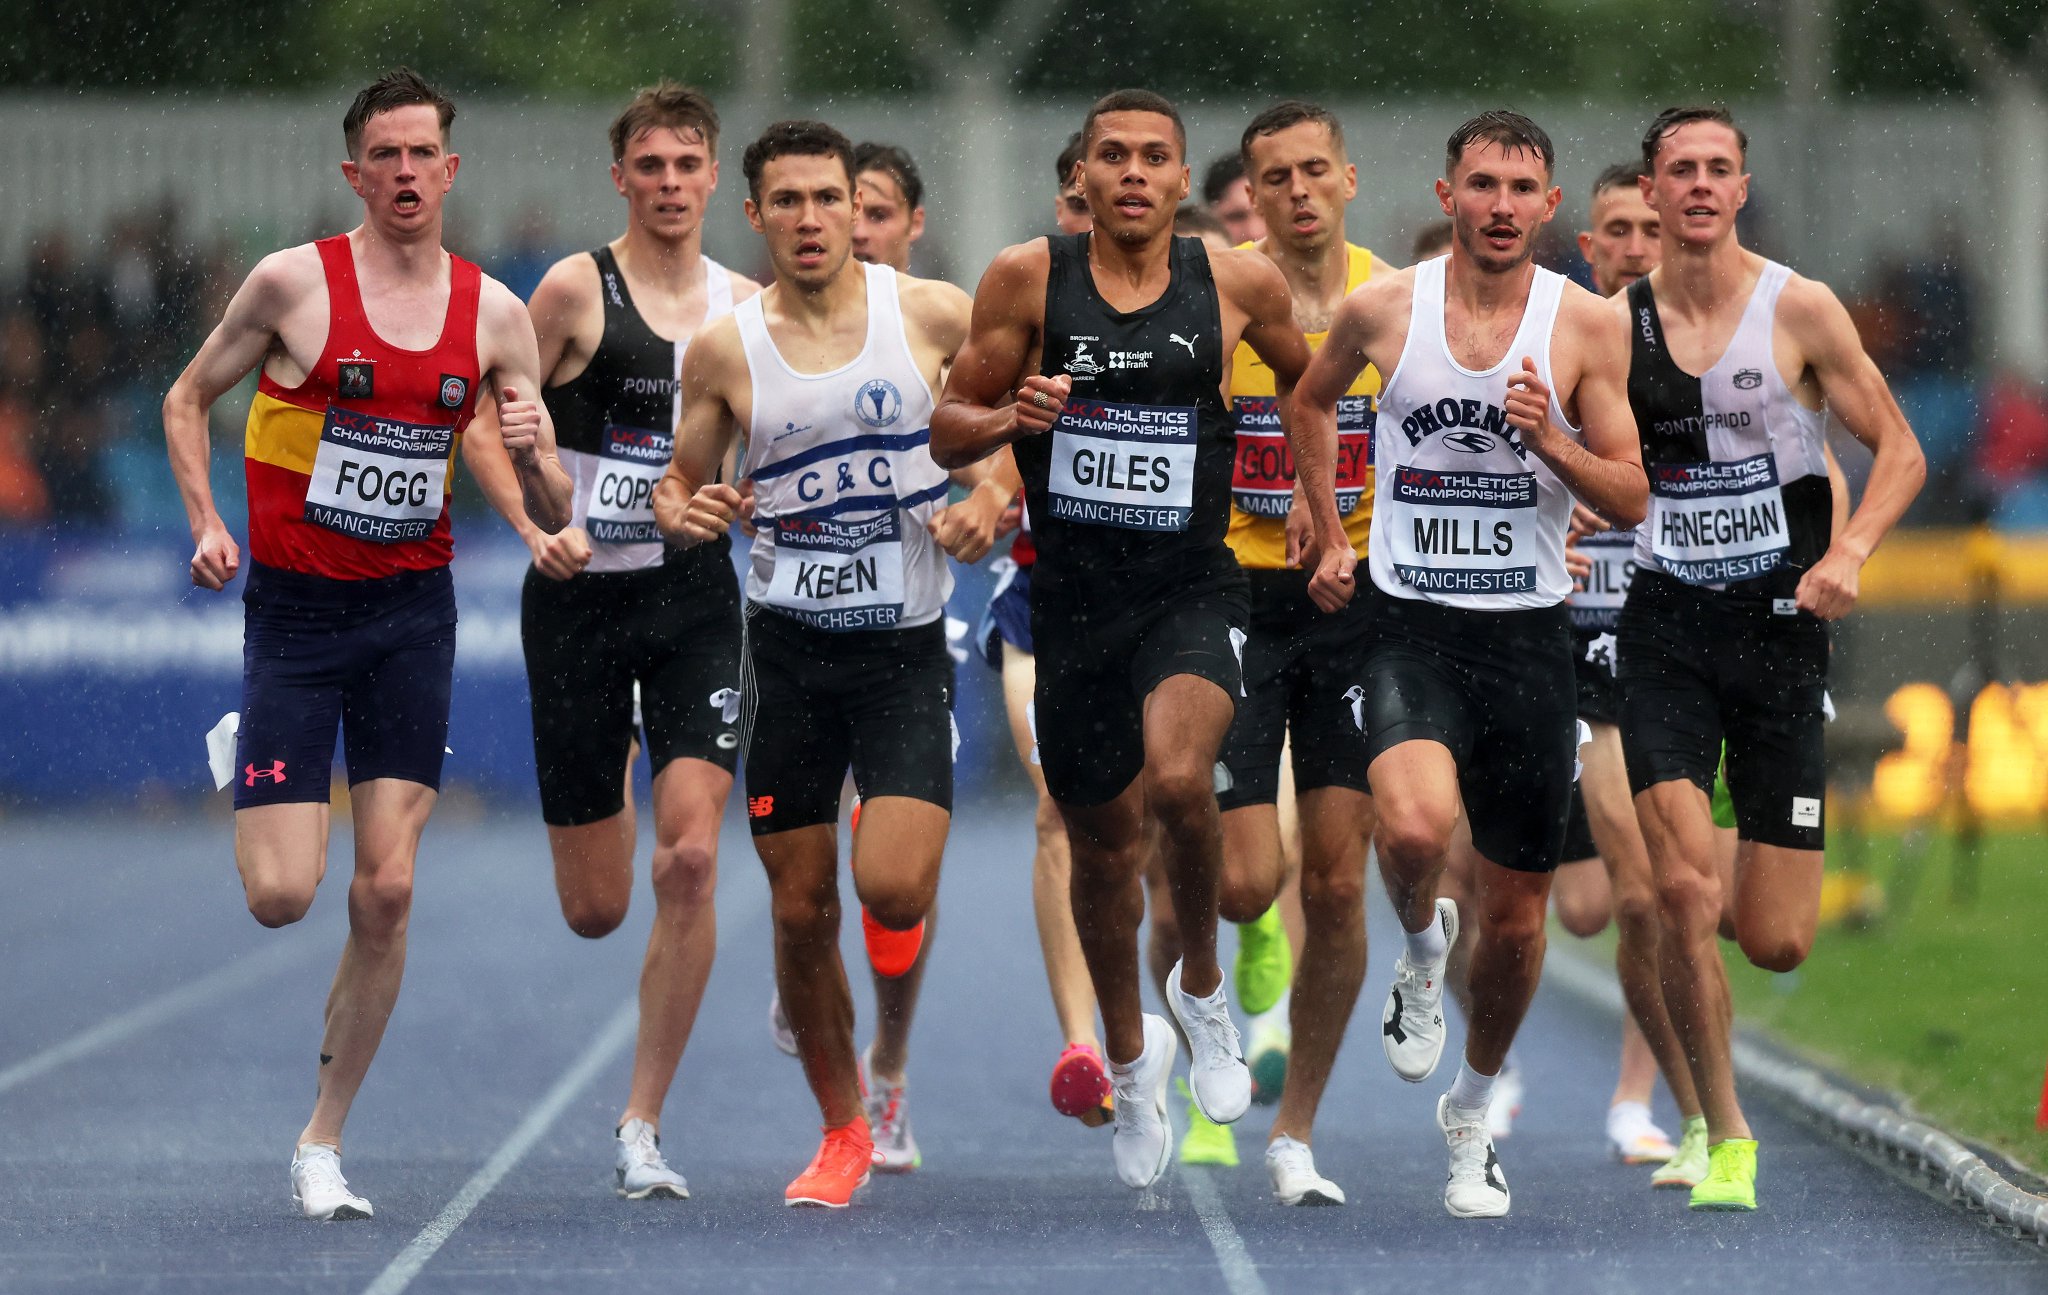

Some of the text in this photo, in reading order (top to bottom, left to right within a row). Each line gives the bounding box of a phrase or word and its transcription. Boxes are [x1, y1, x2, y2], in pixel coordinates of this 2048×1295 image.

[1639, 307, 1657, 345] soar
[1126, 350, 1154, 361] Knight
[1126, 360, 1149, 369] Frank
[1063, 402, 1189, 424] UK ATHLETICS
[1653, 411, 1751, 436] PONTYPRIDD
[334, 412, 451, 441] UK ATHLETICS
[611, 430, 638, 445] UK
[1061, 416, 1189, 436] CHAMPIONSHIPS
[331, 426, 448, 452] CHAMPIONSHIPS
[1072, 449, 1171, 494] GILES
[1241, 443, 1363, 480] GOUEY
[1674, 458, 1769, 481] ATHLETICS
[335, 460, 428, 507] FOGG
[797, 456, 892, 502] C & C
[1401, 470, 1530, 490] UK ATHLETICS
[1660, 471, 1771, 492] CHAMPIONSHIPS
[1400, 485, 1530, 501] CHAMPIONSHIPS
[313, 507, 427, 539] MANCHESTER
[806, 513, 893, 537] ATHLETICS
[1055, 498, 1180, 527] MANCHESTER
[1661, 500, 1780, 548] HENEGHAN
[781, 525, 894, 549] CHAMPIONSHIPS
[1413, 517, 1513, 557] MILLS
[793, 556, 878, 600] KEEN
[1400, 568, 1526, 589] MANCHESTER
[1661, 552, 1782, 580] MANCHESTER
